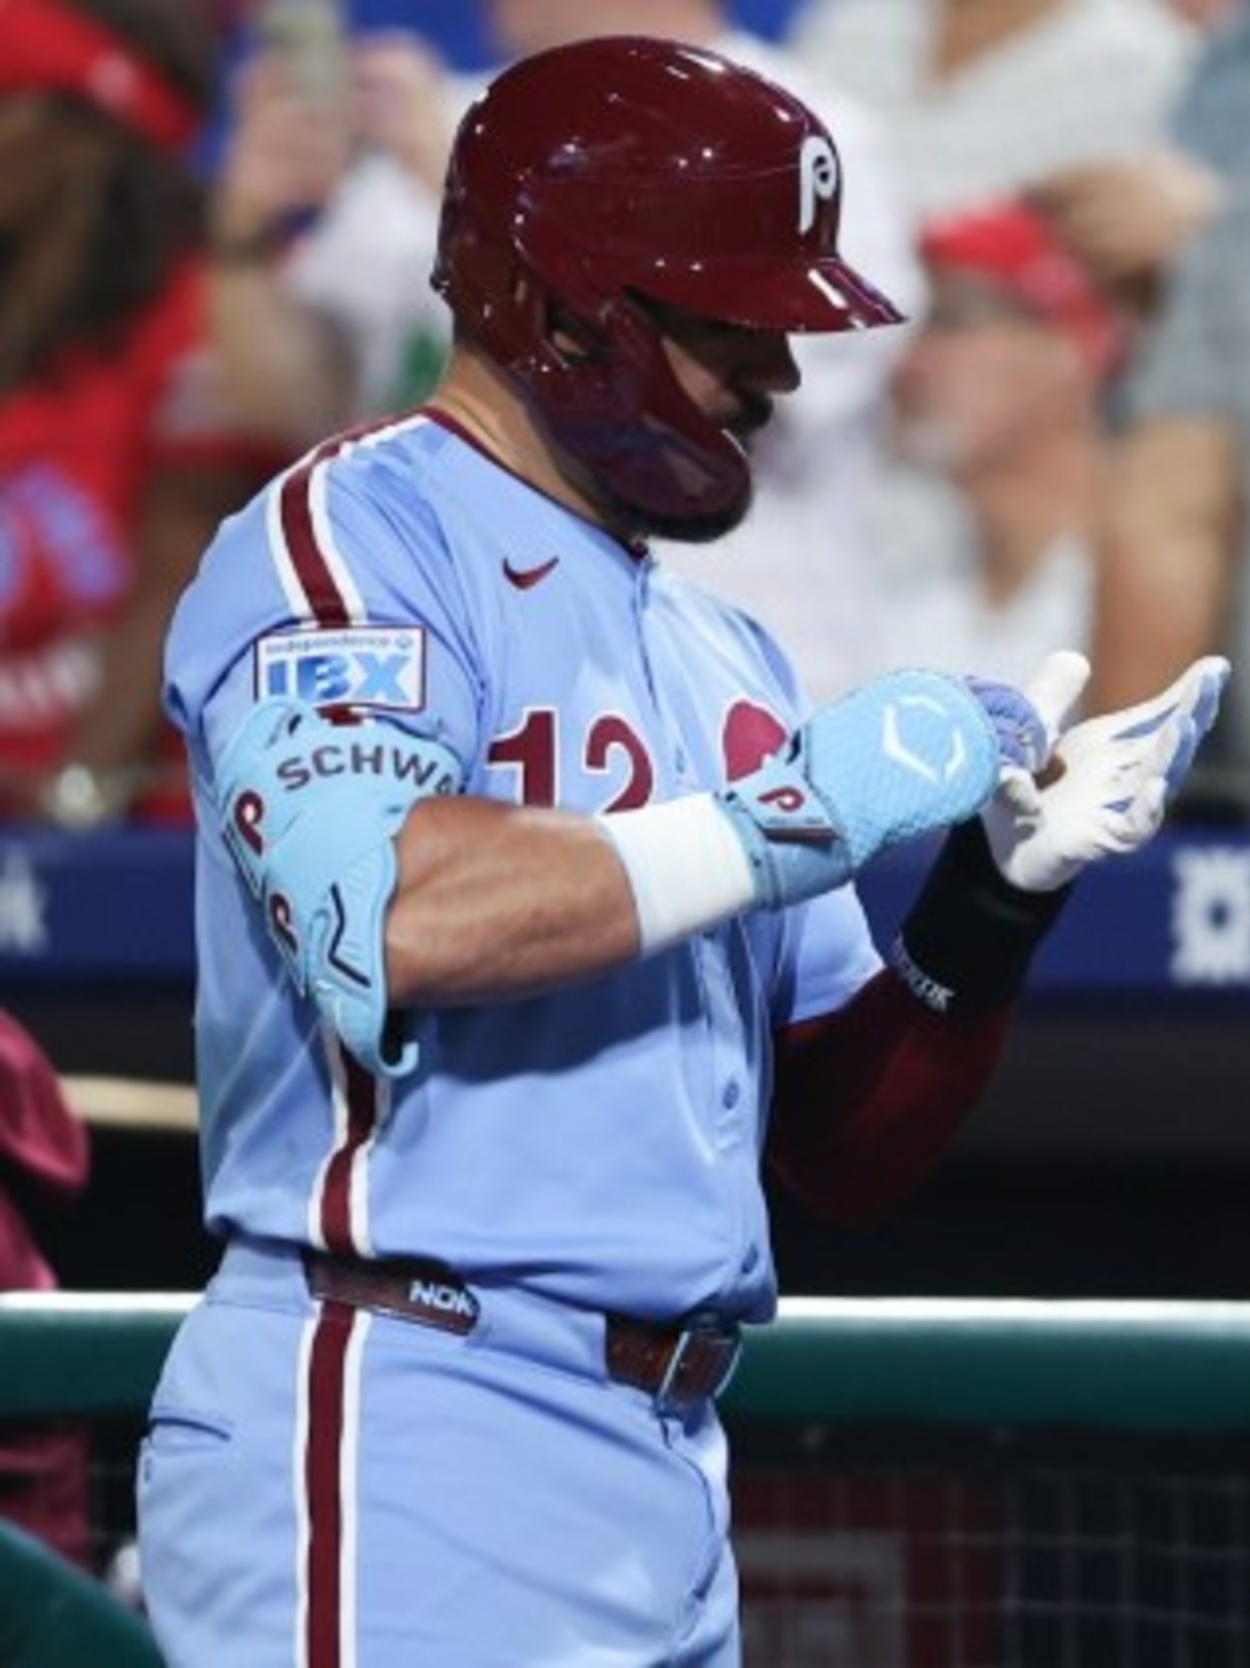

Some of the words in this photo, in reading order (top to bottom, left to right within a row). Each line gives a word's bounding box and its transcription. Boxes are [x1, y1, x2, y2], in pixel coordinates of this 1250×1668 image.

[799, 135, 838, 235] P
[267, 653, 411, 701] IBX
[486, 710, 655, 815] 12
